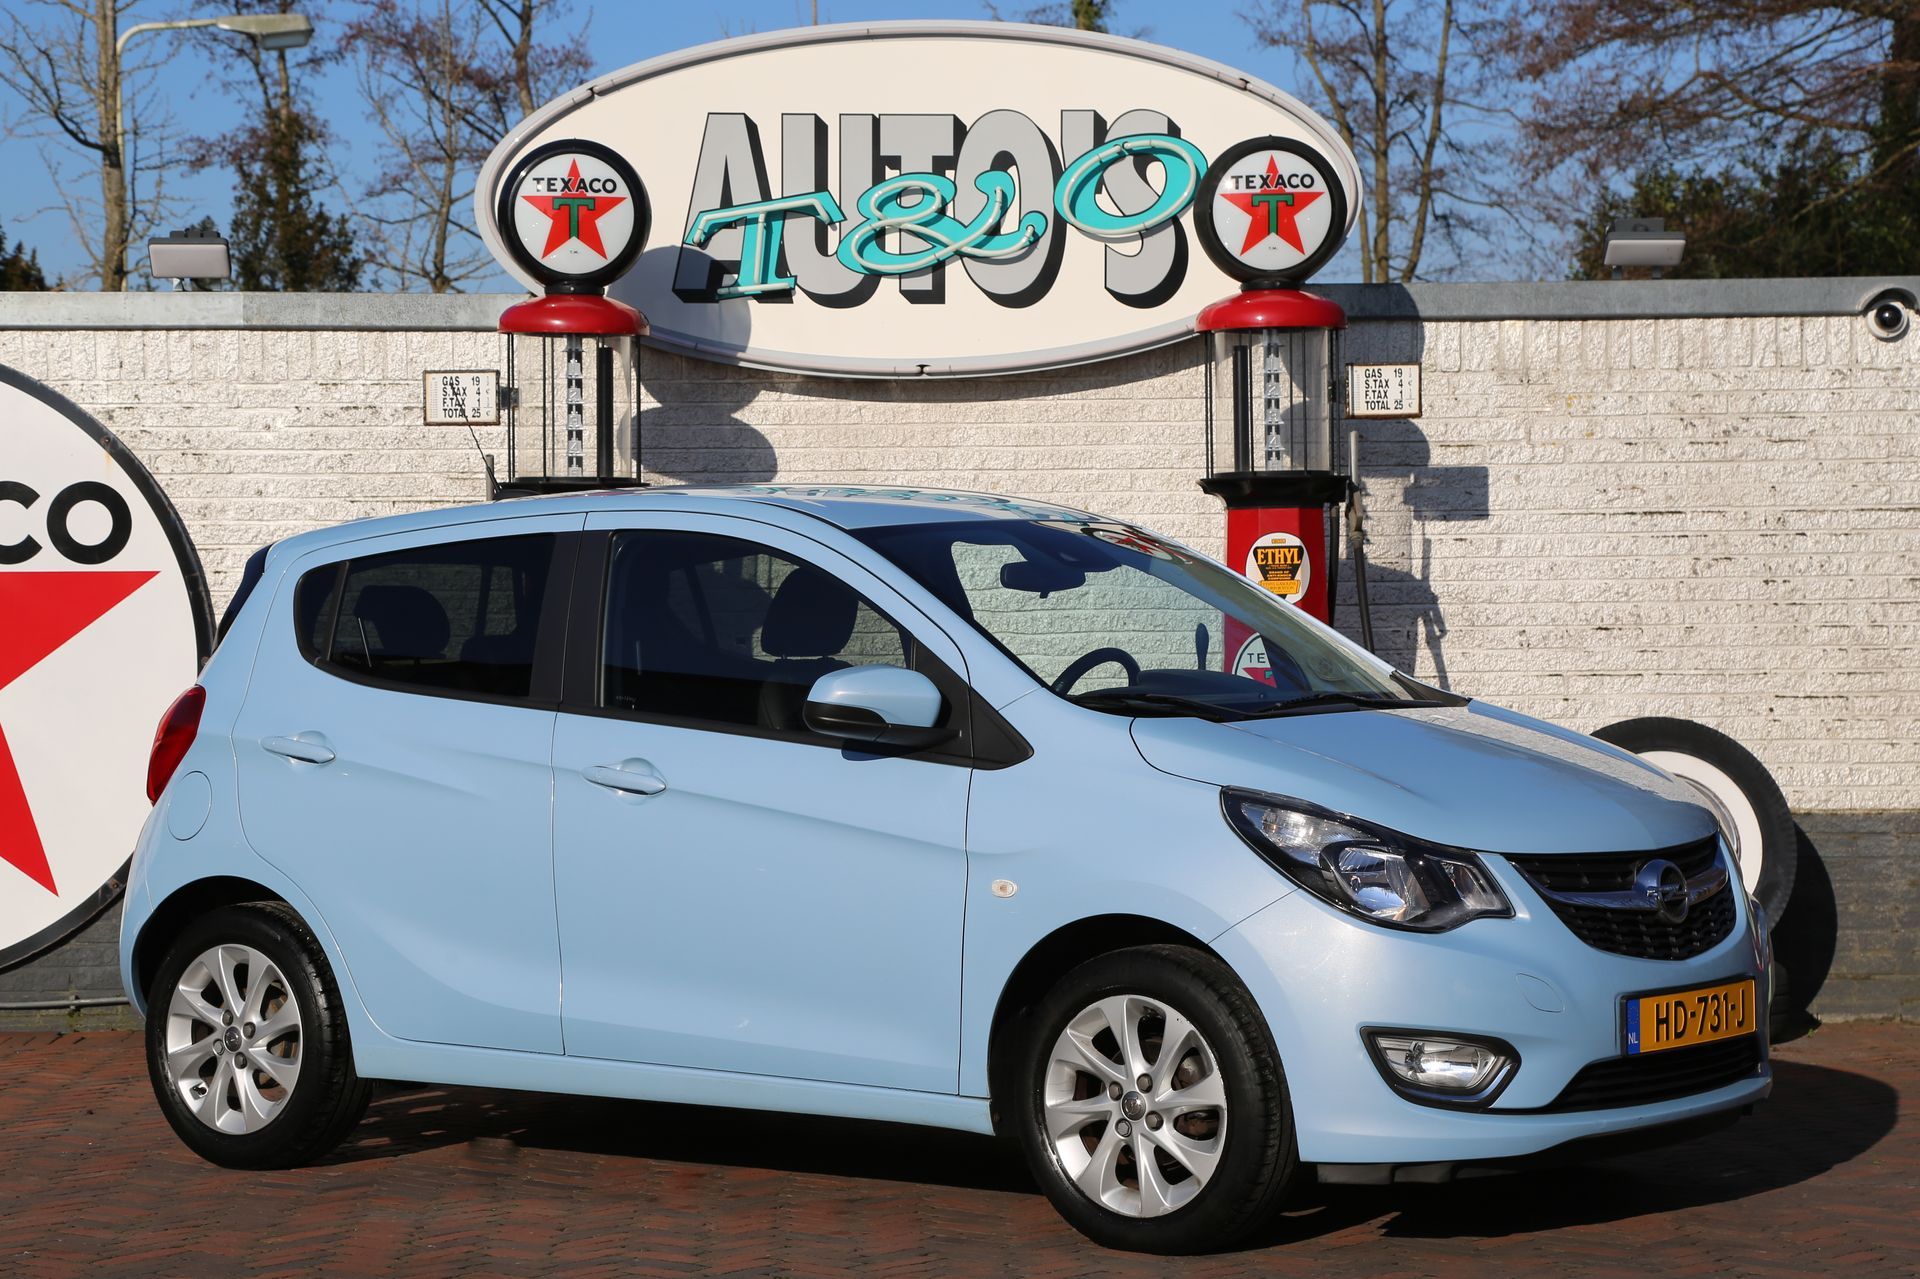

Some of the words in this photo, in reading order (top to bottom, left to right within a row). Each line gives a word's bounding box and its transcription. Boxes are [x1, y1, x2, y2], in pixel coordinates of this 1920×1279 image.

[532, 177, 617, 193] TEXACO
[1231, 174, 1315, 189] TEXACO
[672, 109, 1188, 309] AUTO'S
[552, 197, 595, 239] T
[1252, 194, 1294, 235] T
[1364, 368, 1382, 378] GAS
[1394, 368, 1403, 378] 19
[442, 376, 460, 386] GAS
[471, 376, 480, 386] 19
[1364, 379, 1389, 389] S.TAX
[1398, 379, 1403, 389] 4
[442, 387, 467, 397] S.TAX
[476, 387, 481, 397] 4
[1365, 390, 1388, 400] F.TAX
[442, 398, 466, 407] F.TAX
[1365, 400, 1390, 410] TOTAL
[1394, 400, 1403, 410] 25
[442, 408, 468, 418] TOTAL
[471, 408, 481, 418] 25
[1256, 548, 1301, 565] ETHYL
[1628, 1032, 1639, 1045] NL
[1654, 988, 1745, 1043] HD-731-J
